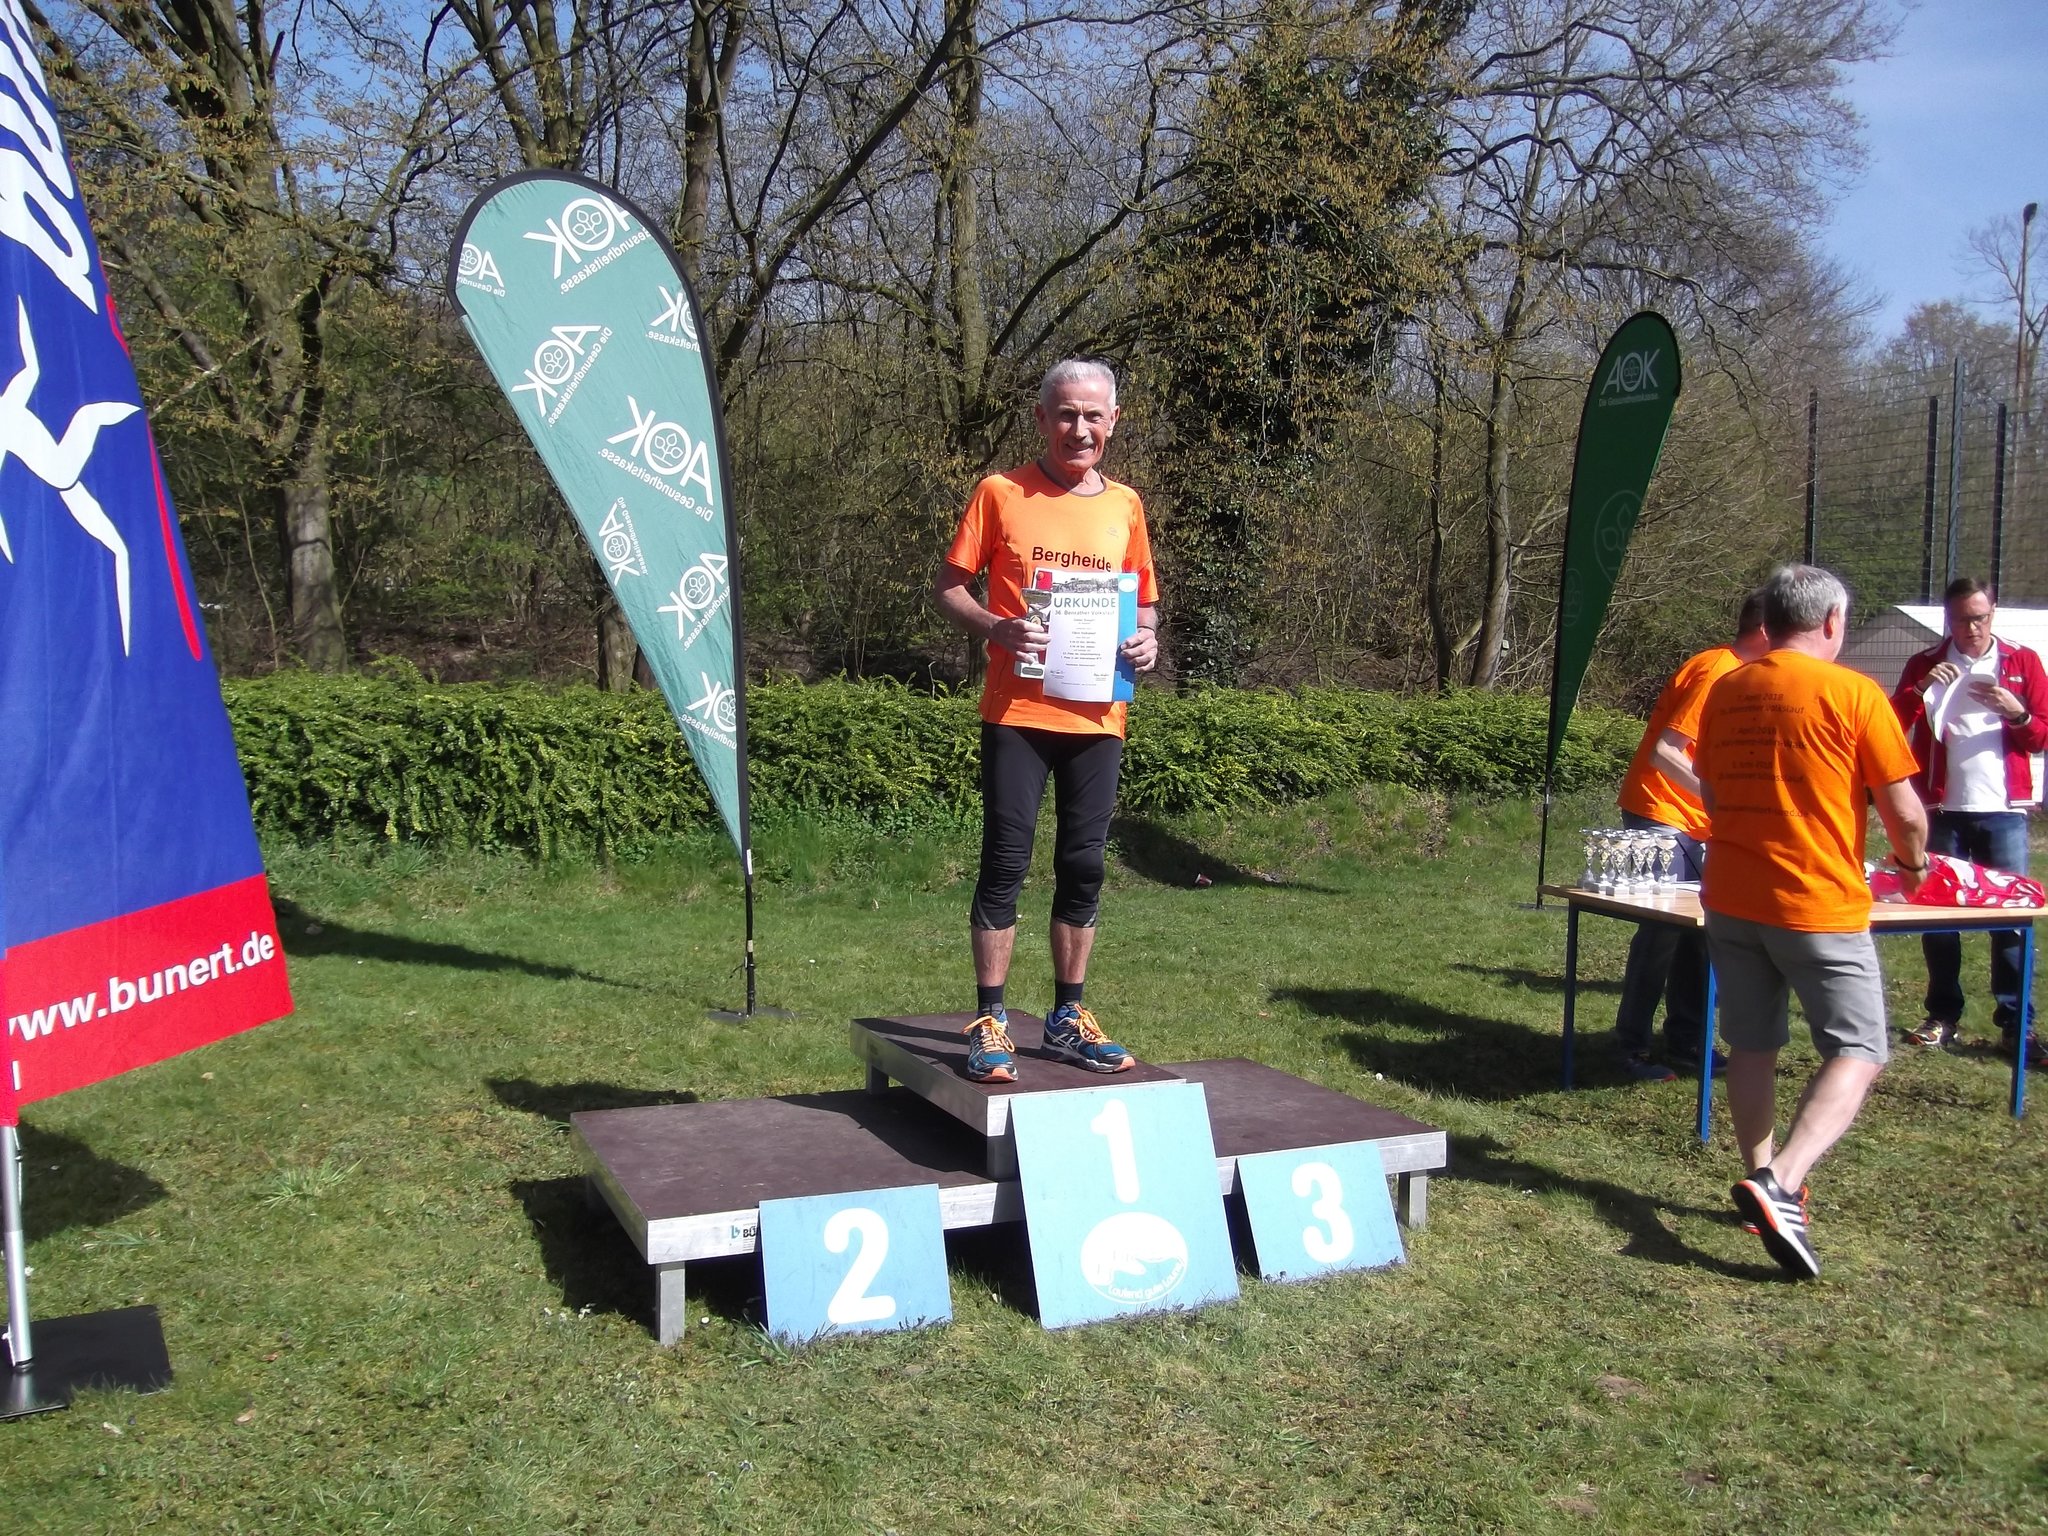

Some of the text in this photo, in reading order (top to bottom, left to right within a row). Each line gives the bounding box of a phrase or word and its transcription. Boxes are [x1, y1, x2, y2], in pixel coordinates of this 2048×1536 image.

[1600, 348, 1660, 395] AOK
[1032, 546, 1112, 573] Bergheide
[1053, 597, 1117, 608] URKUNDE
[8, 930, 276, 1041] ww.bunert.de
[1089, 1100, 1140, 1204] 1
[1290, 1162, 1355, 1263] 3
[823, 1207, 896, 1325] 2
